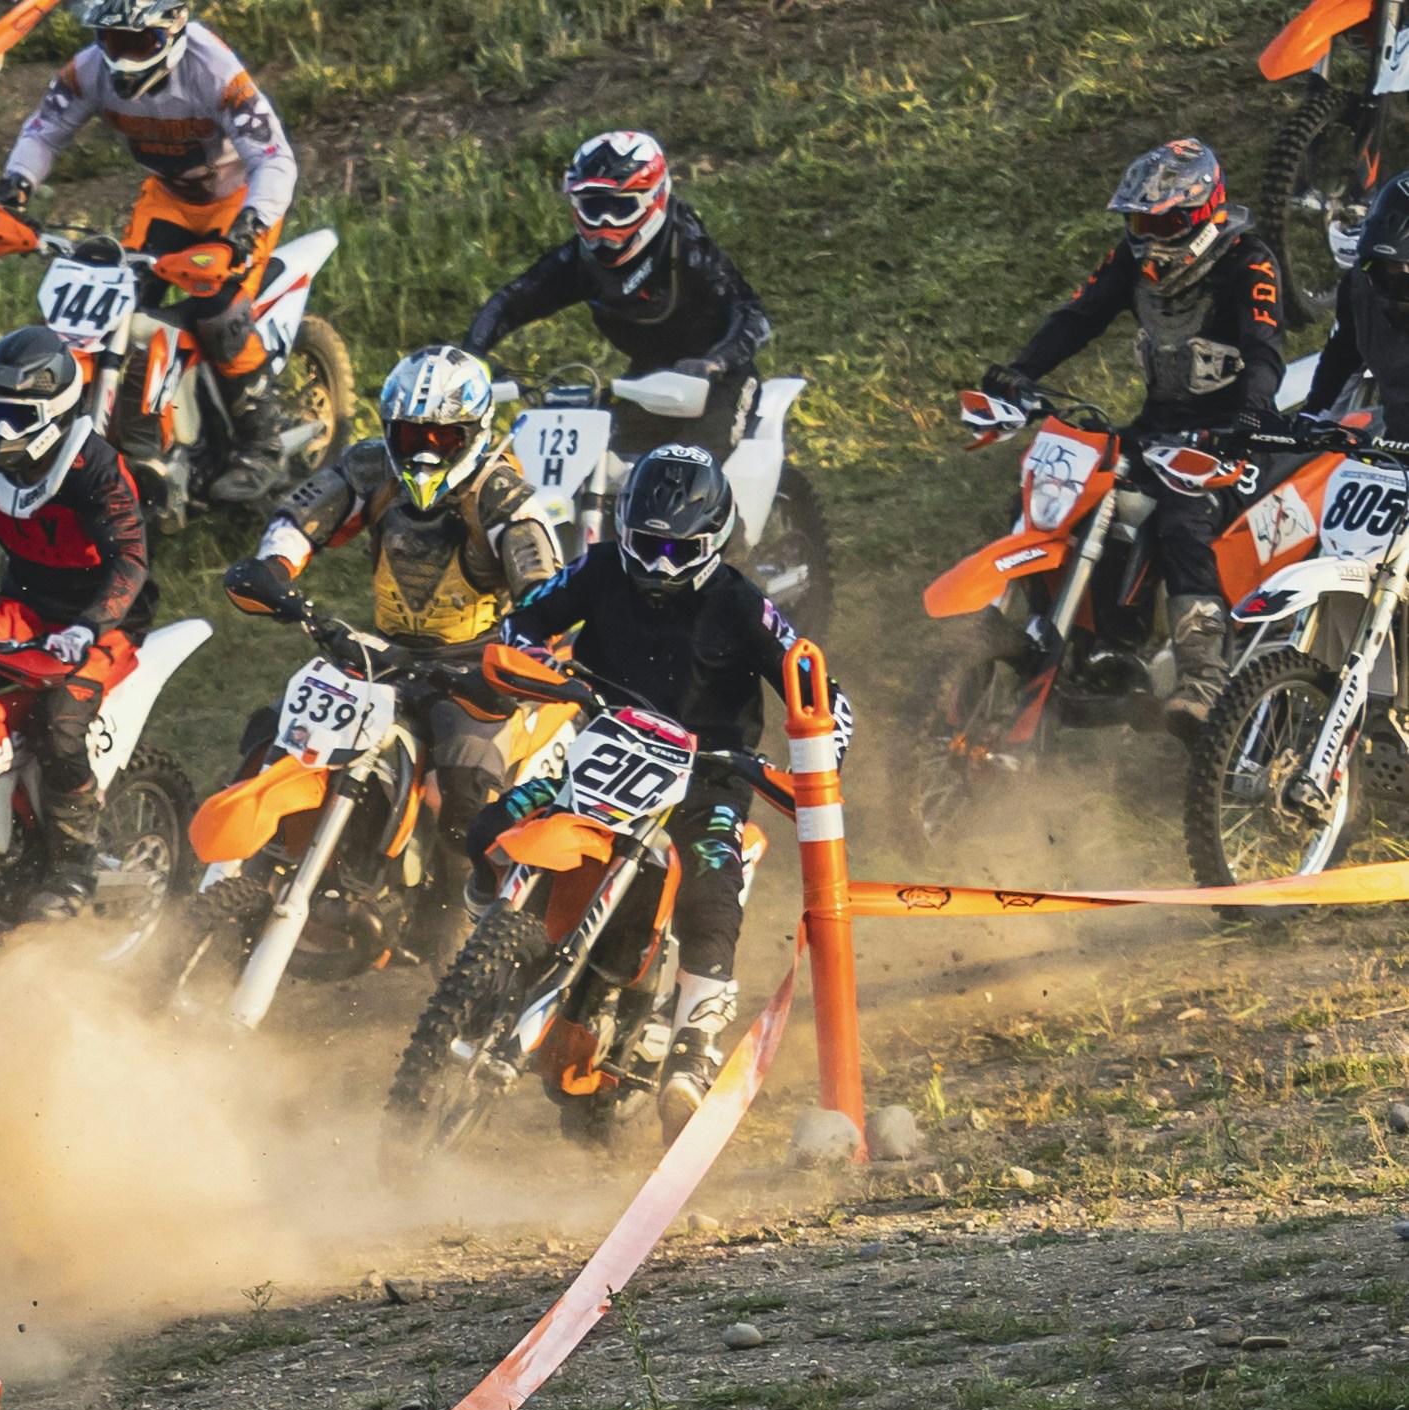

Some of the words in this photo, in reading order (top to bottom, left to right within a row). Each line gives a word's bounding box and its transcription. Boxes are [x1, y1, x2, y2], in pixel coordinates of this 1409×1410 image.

[539, 428, 579, 456] 123
[542, 458, 564, 487] H
[1323, 481, 1407, 537] 805
[1321, 674, 1358, 766] DUNLOP
